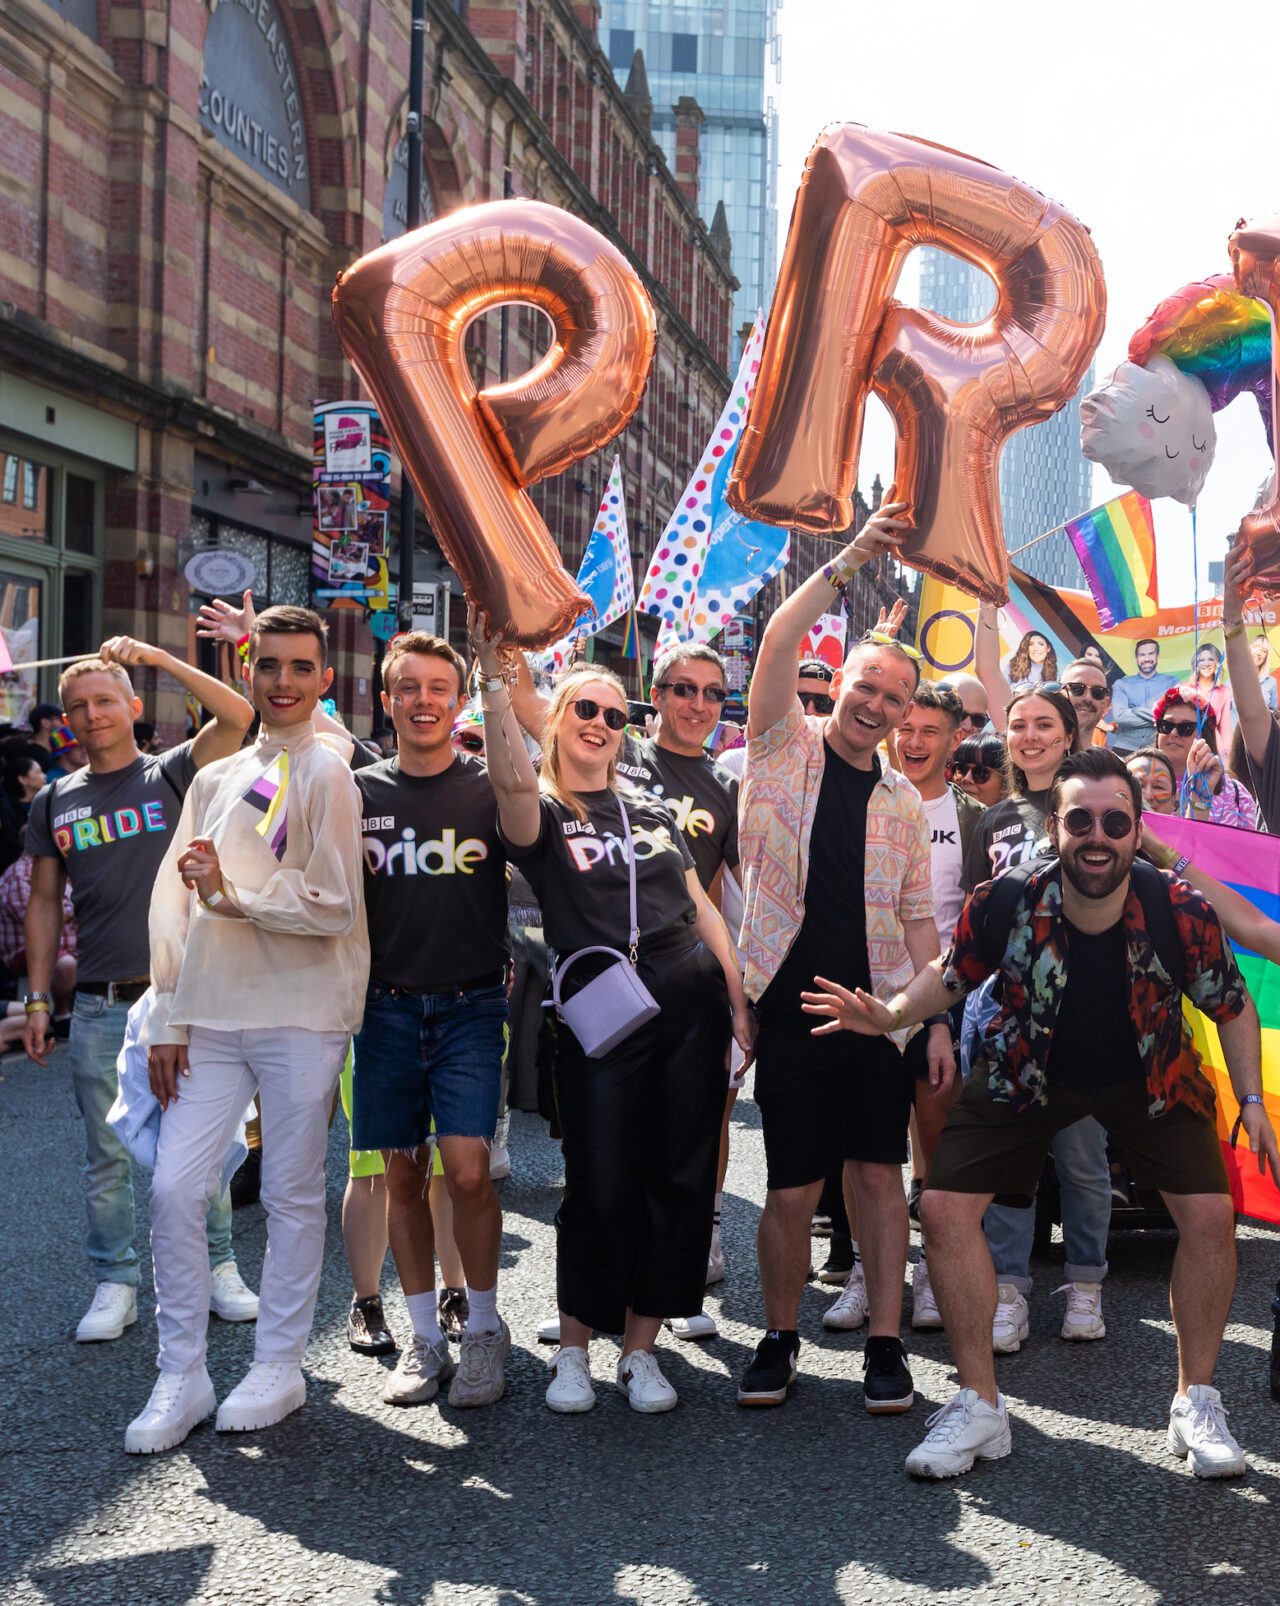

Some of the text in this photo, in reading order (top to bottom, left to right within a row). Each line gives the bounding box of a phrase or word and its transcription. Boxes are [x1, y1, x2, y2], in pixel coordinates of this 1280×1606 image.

[416, 605, 432, 615] Stop
[616, 762, 652, 780] BBC
[54, 806, 92, 829] BBC
[563, 820, 597, 835] BC
[53, 800, 167, 858] PRIDE
[993, 823, 1022, 844] BBC
[988, 830, 1051, 876] Pri
